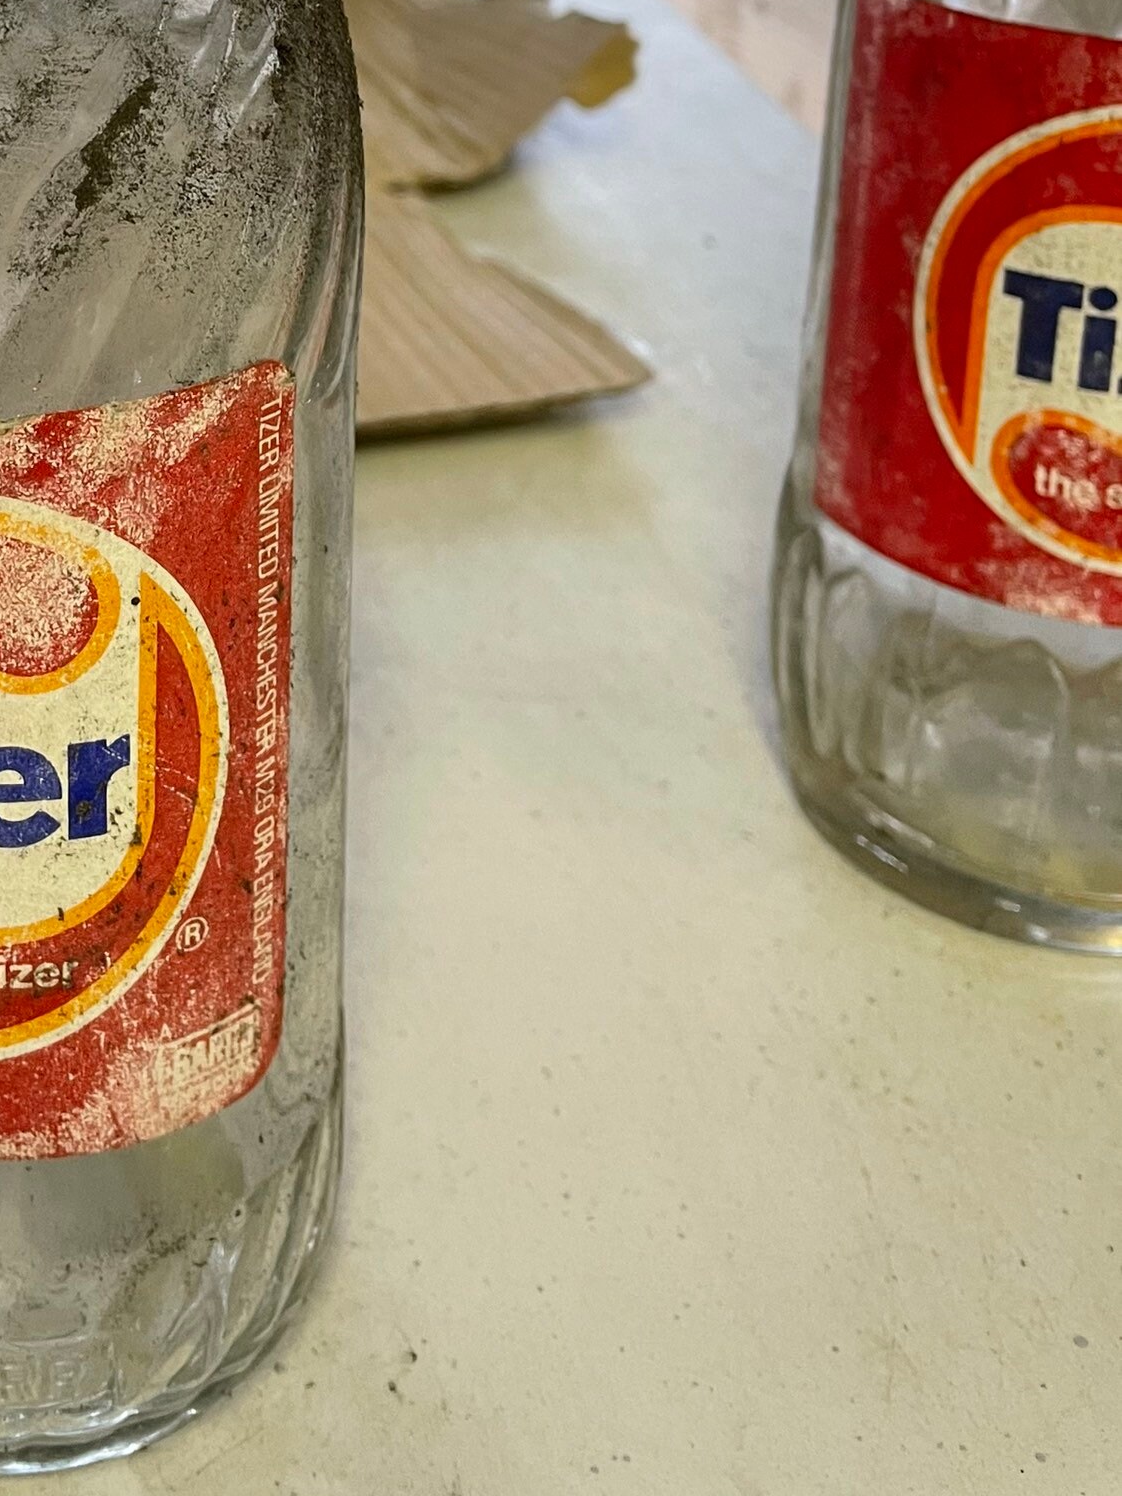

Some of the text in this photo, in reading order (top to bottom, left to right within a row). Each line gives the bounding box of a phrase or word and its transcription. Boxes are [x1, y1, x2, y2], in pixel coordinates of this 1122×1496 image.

[1003, 268, 1122, 392] Ti
[260, 394, 282, 470] TIZER
[258, 470, 279, 579] LIMITED
[1034, 464, 1101, 511] the
[256, 581, 278, 756] MANCHESTER
[255, 756, 276, 814] M29
[252, 871, 273, 984] ENGLAND
